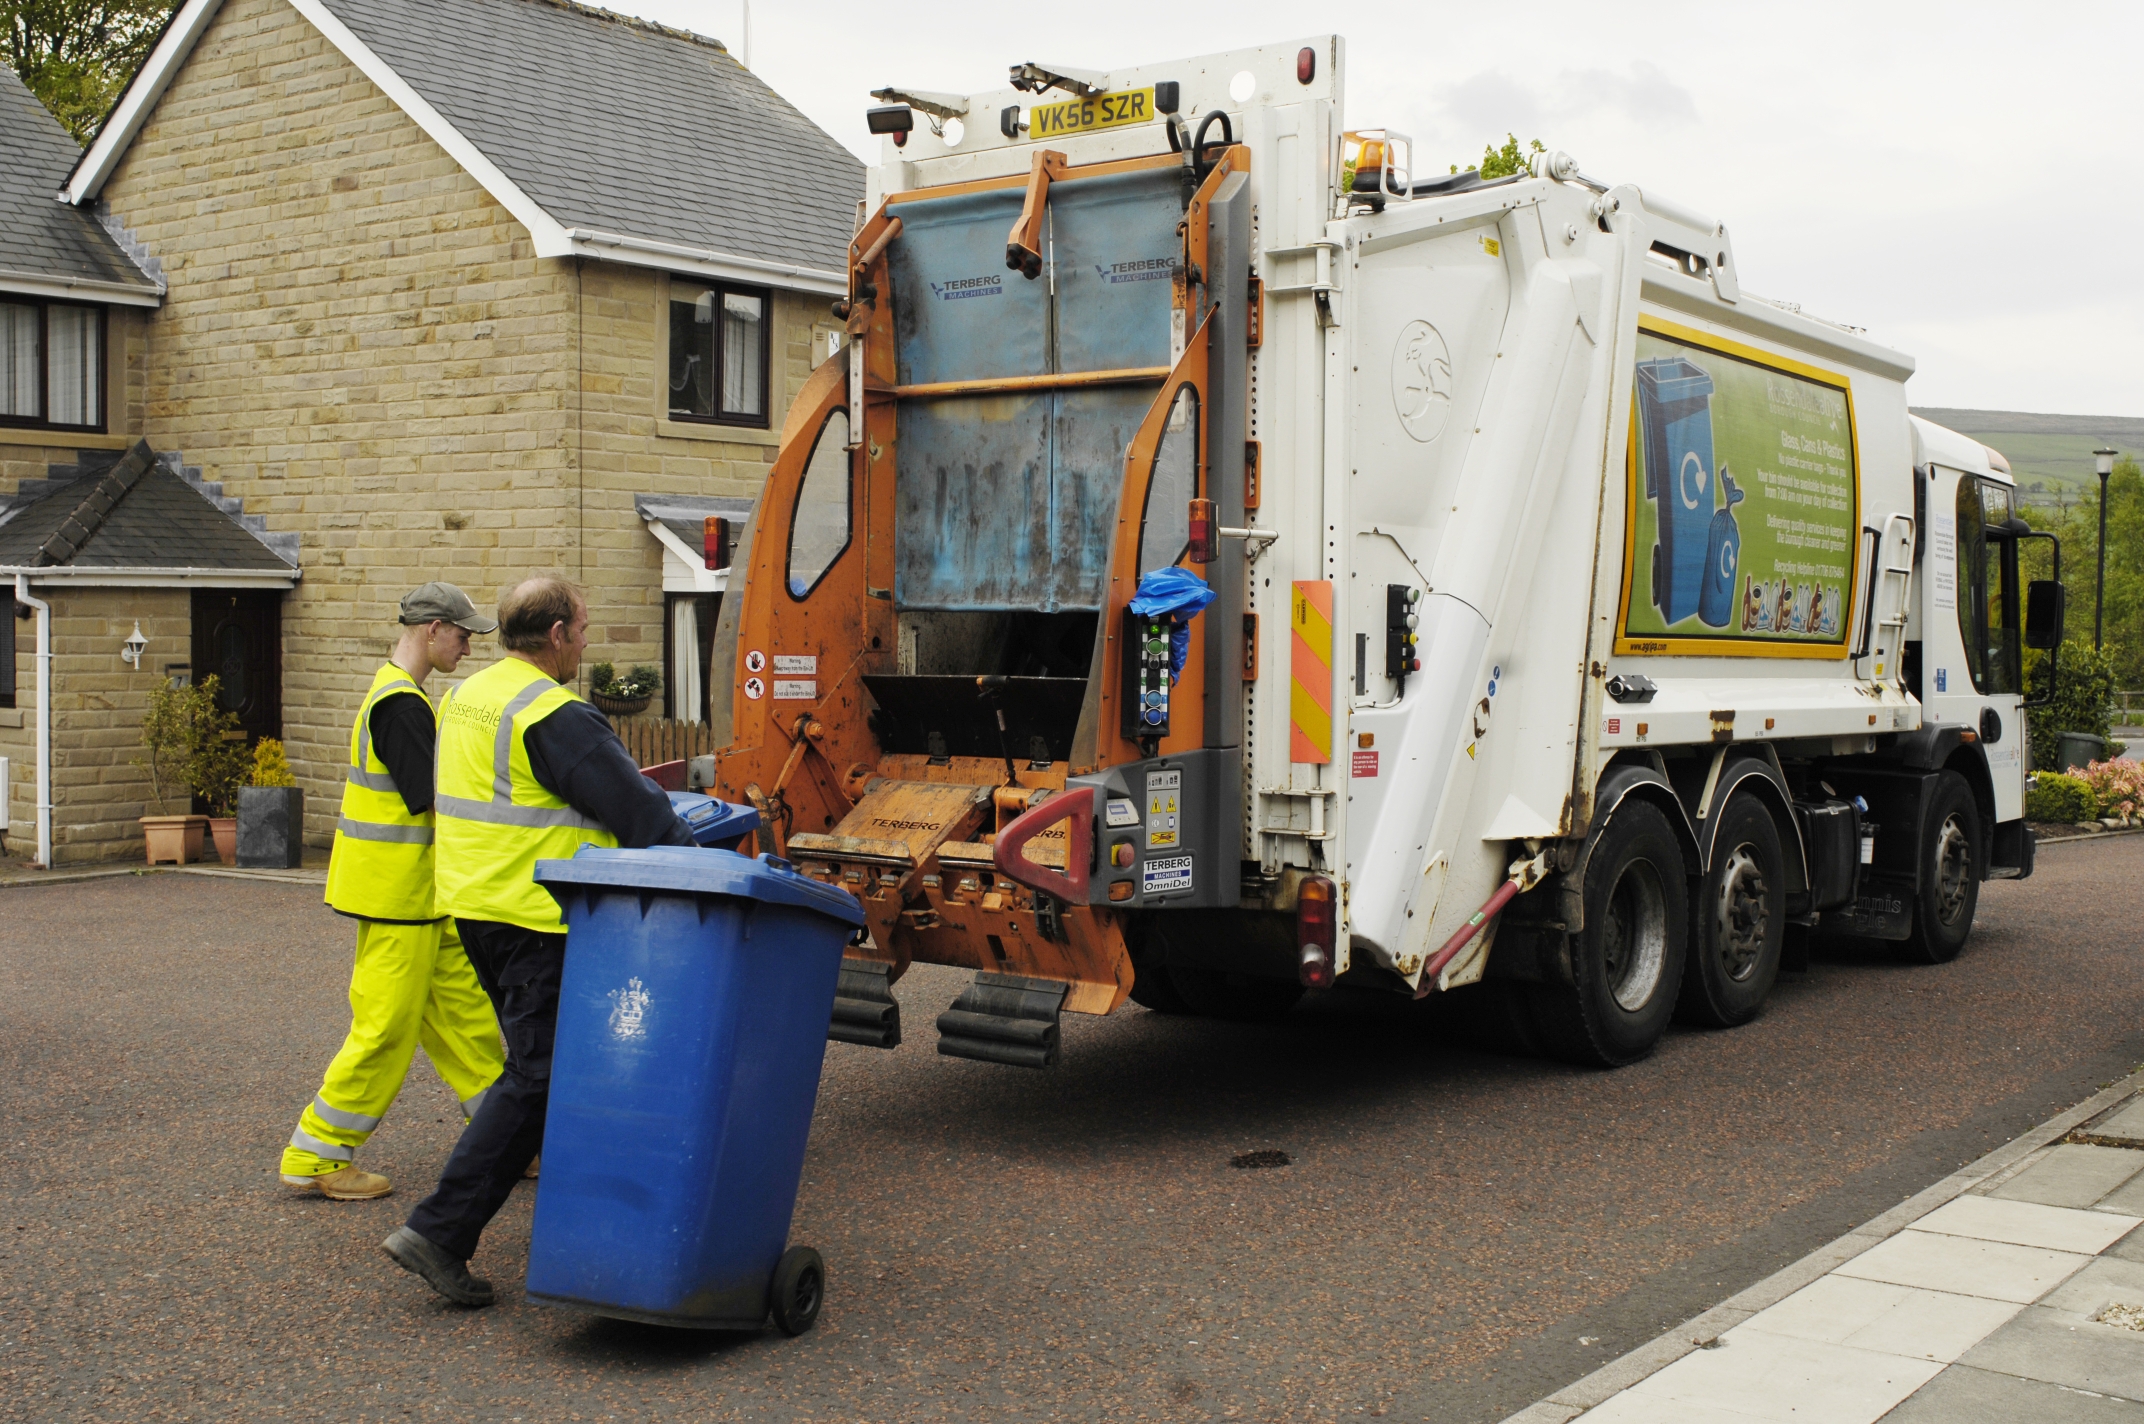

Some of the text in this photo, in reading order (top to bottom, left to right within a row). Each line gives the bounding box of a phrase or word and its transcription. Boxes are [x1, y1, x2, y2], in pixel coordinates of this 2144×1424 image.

[1038, 92, 1145, 133] VK56 SZR
[1110, 257, 1177, 273] TERBERG
[943, 275, 1001, 291] TERBERG
[949, 287, 998, 299] MACHINES
[231, 597, 237, 607] 7
[177, 676, 183, 688] 7
[468, 720, 497, 737] COUNCIL
[872, 818, 940, 831] TERBERG
[1145, 857, 1191, 871] TERBERG
[1154, 870, 1182, 879] MACHINES
[1144, 878, 1190, 891] OmniDel
[1857, 893, 1902, 914] nnis
